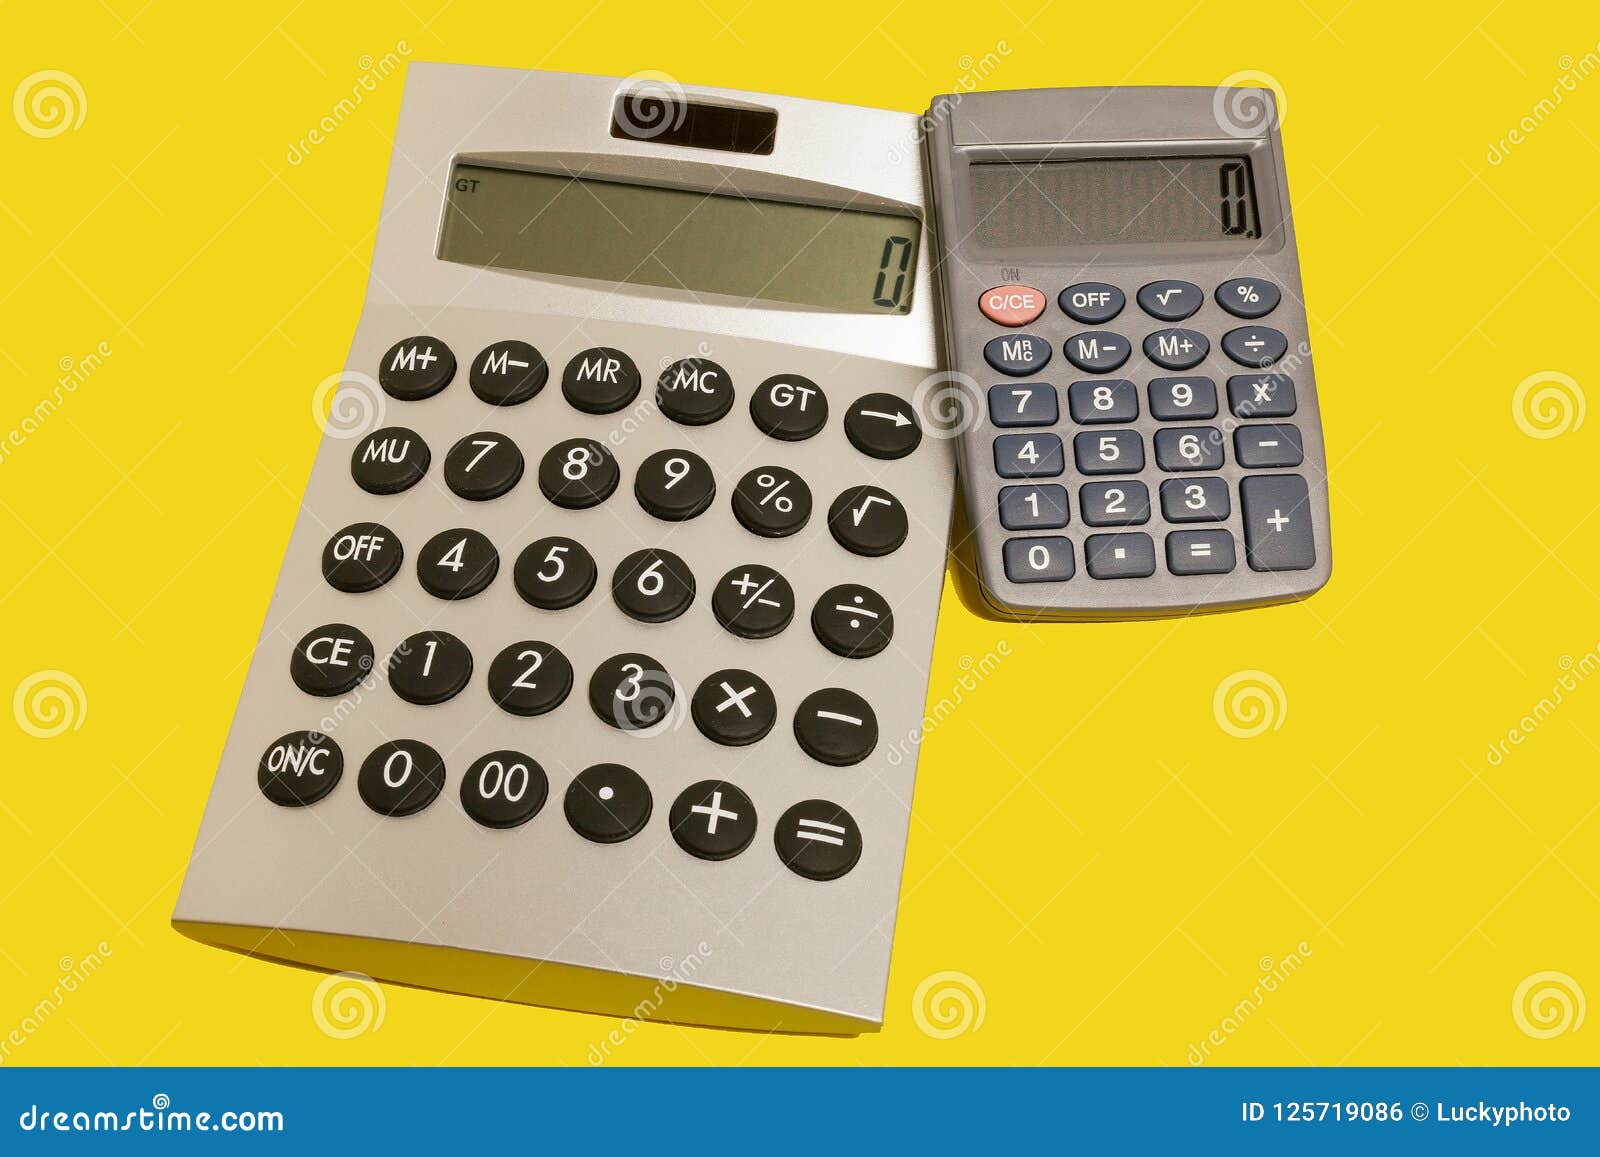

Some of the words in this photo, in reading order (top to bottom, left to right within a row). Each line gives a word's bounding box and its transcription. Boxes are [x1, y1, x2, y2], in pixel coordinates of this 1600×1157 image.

[455, 178, 480, 194] GT
[1001, 268, 1020, 281] ON
[989, 294, 1036, 310] C/CE
[1072, 293, 1111, 307] OFF
[1237, 285, 1259, 303] %
[390, 346, 437, 371] M+
[1159, 336, 1193, 357] M+
[576, 357, 621, 384] MR
[673, 368, 718, 394] MC
[770, 383, 816, 411] GT
[1012, 390, 1032, 413] 7
[1093, 386, 1114, 411] 8
[1172, 383, 1193, 407] 9
[362, 438, 410, 463] MU
[465, 440, 498, 472] 7
[1018, 441, 1039, 464] 4
[1099, 437, 1120, 461] 5
[1178, 434, 1200, 459] 6
[562, 447, 590, 481] 8
[664, 458, 690, 490] 9
[756, 474, 793, 513] %
[1025, 493, 1039, 517] 1
[1104, 489, 1126, 513] 2
[1185, 485, 1206, 509] 3
[333, 535, 384, 562] OFF
[437, 538, 468, 572] 4
[1029, 545, 1049, 570] 0
[536, 546, 569, 582] 5
[637, 559, 664, 596] 6
[306, 637, 354, 666] CE
[422, 641, 438, 677] 1
[512, 650, 543, 689] 2
[615, 663, 644, 701] 3
[267, 745, 330, 777] ON/C
[383, 750, 413, 788] 0
[479, 760, 529, 802] 00
